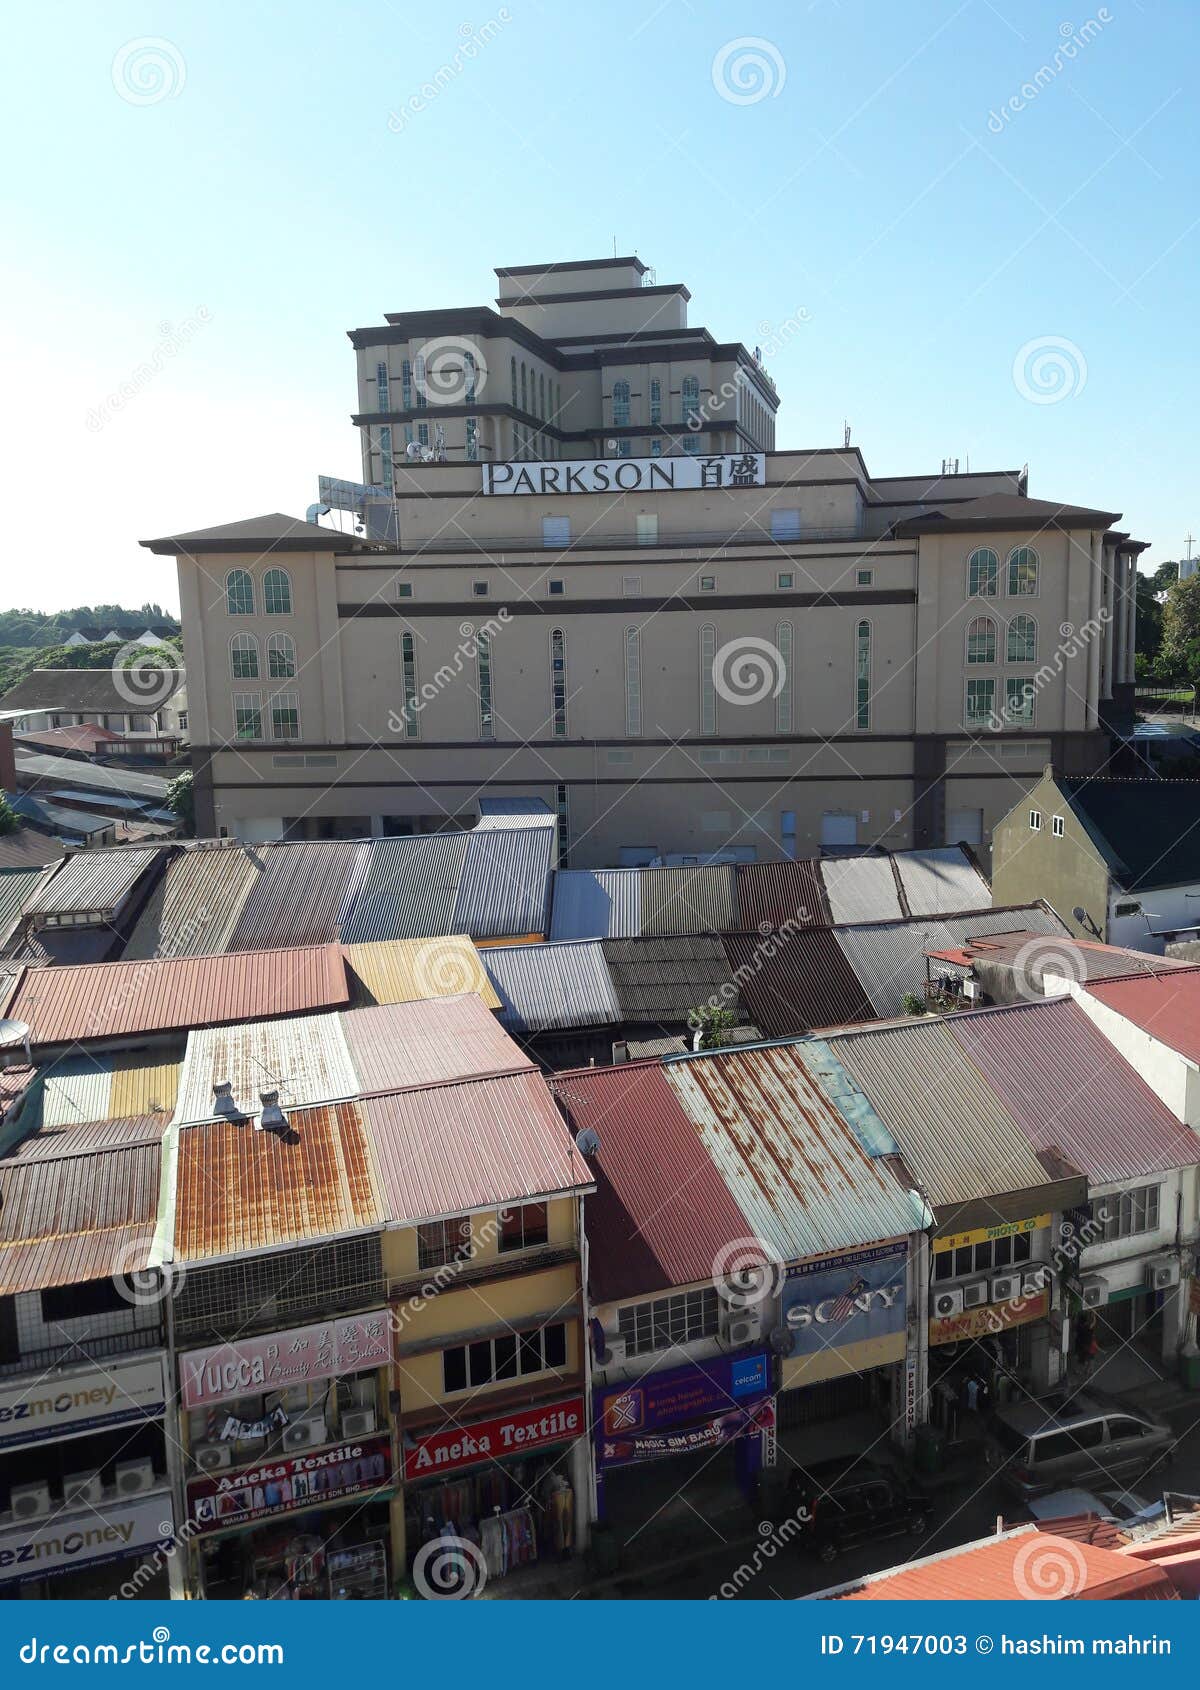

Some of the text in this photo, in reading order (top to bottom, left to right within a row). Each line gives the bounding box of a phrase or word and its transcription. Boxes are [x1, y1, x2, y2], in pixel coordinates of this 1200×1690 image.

[488, 462, 674, 494] PARKSON
[695, 454, 760, 487] 百盛
[190, 1354, 266, 1397] Yucca
[415, 1435, 491, 1469] Aneka
[501, 1410, 578, 1447] Textile
[668, 1435, 688, 1447] SIM
[216, 1446, 363, 1492] Aneka Textile
[0, 1520, 135, 1567] ezmoney
